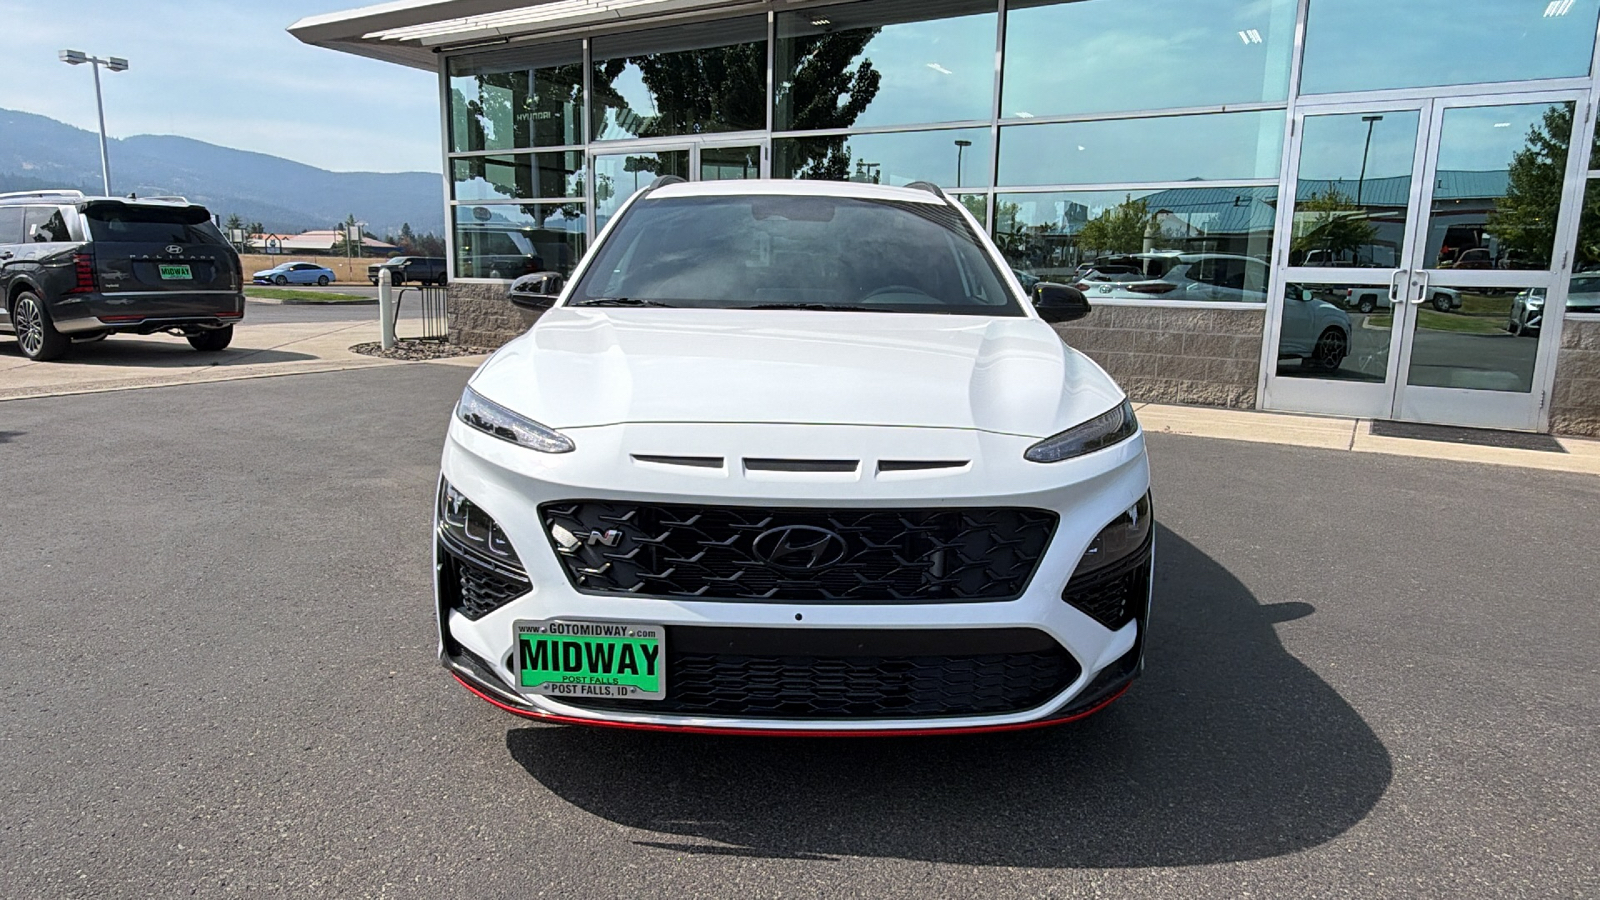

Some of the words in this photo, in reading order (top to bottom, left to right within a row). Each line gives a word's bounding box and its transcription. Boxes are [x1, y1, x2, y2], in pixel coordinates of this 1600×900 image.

[516, 111, 551, 121] HYUNDAI
[161, 267, 190, 275] MIDWAY
[549, 623, 628, 637] GOTOMIDWAY
[519, 639, 659, 676] MIDWAY
[562, 675, 587, 684] POST
[589, 676, 619, 684] FALLS
[551, 684, 577, 695] POST
[580, 685, 614, 697] FALLS,
[617, 686, 628, 696] ID
